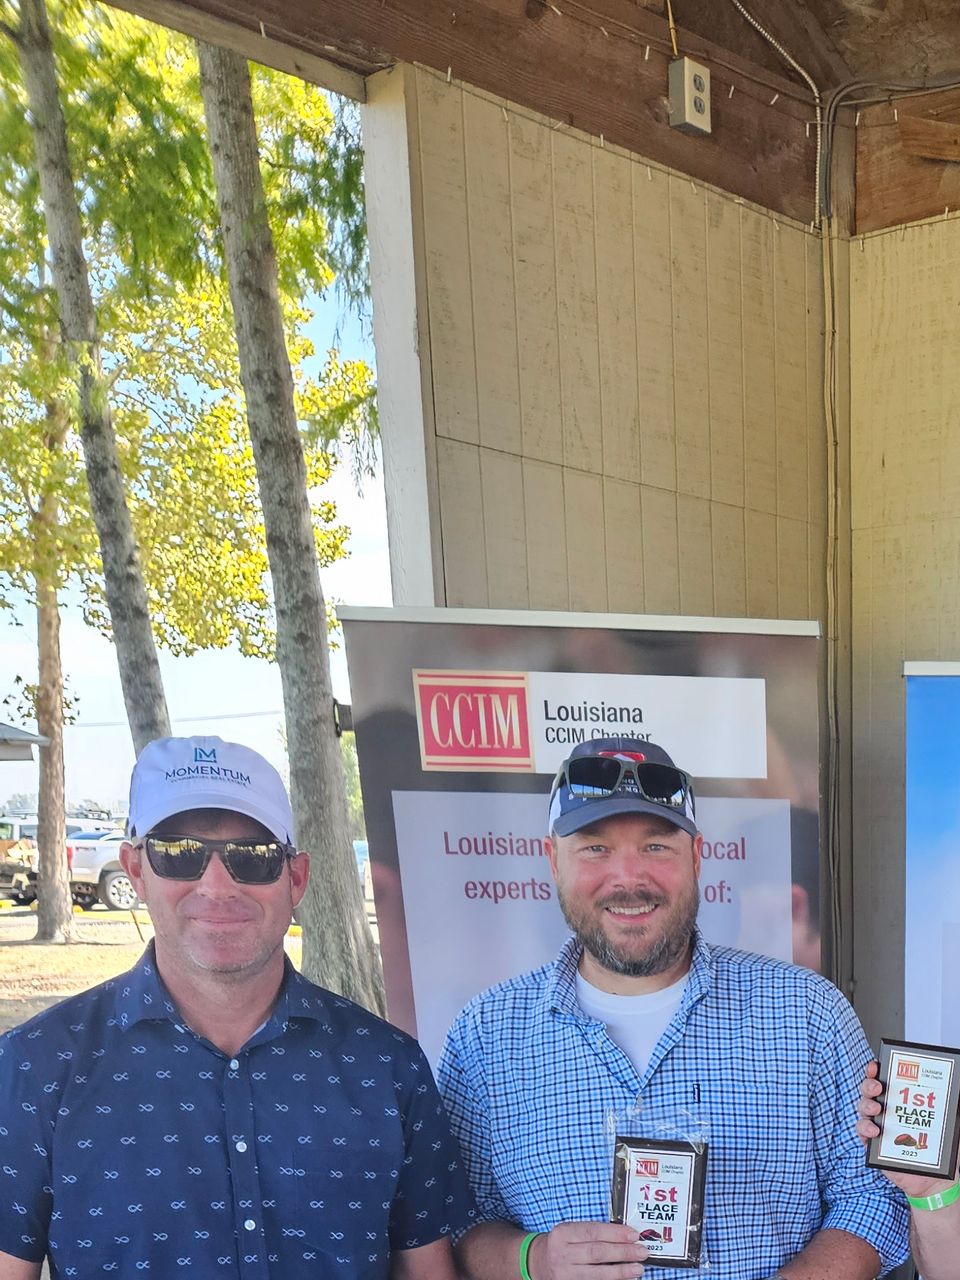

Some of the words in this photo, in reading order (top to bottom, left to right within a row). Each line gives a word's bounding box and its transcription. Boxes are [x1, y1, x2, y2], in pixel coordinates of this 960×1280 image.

[429, 692, 522, 750] CCIM
[544, 700, 643, 723] Louisiana
[545, 727, 585, 743] CCIM
[165, 766, 252, 785] MOMENTUM
[443, 831, 543, 857] Louisian
[701, 837, 746, 860] ocal
[464, 878, 551, 904] experts
[704, 880, 731, 903] of:
[899, 1063, 919, 1079] CCIM
[899, 1087, 936, 1109] 1st
[895, 1105, 936, 1119] PLACE
[897, 1114, 932, 1127] TEAM
[901, 1149, 918, 1157] 2023
[640, 1184, 678, 1203] 1st
[639, 1211, 675, 1221] TEAM
